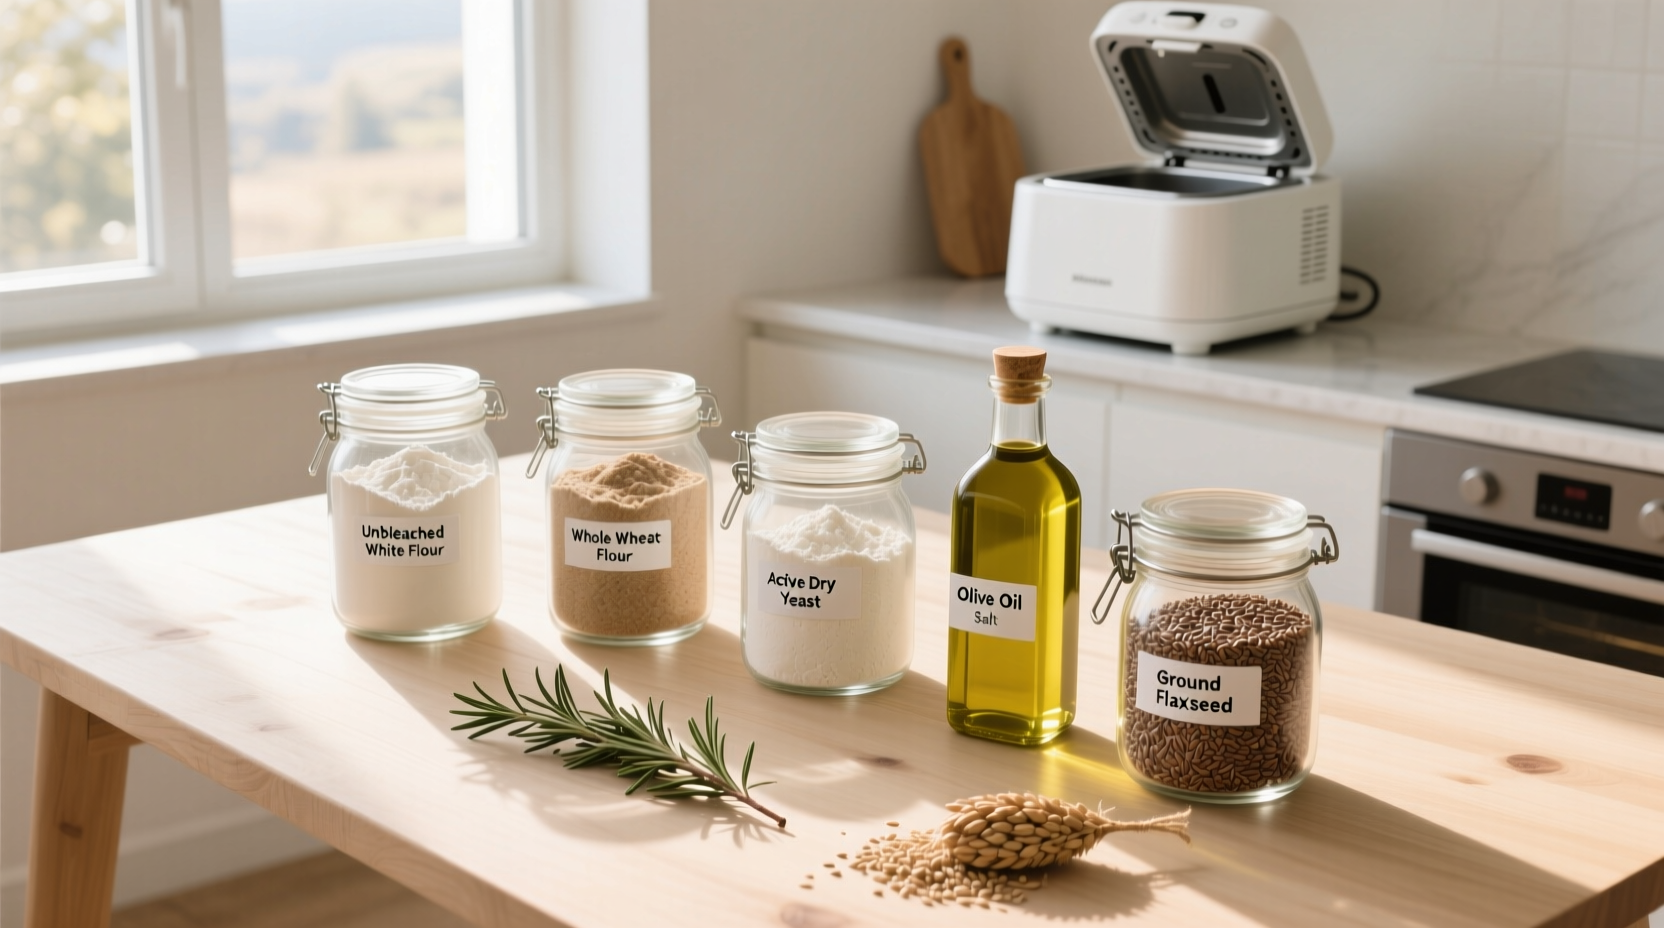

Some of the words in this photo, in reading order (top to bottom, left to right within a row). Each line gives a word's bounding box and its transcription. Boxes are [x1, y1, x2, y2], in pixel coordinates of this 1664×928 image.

[362, 524, 444, 540] Unbleached
[571, 527, 612, 545] Whole
[615, 530, 662, 545] Wheat
[365, 543, 405, 557] White
[408, 544, 445, 557] Flour
[597, 548, 633, 562] Flour
[809, 575, 836, 594] Dry
[780, 591, 821, 609] Yeast
[957, 586, 995, 606] Olive
[999, 593, 1022, 611] Oil
[974, 610, 999, 626] Salt
[1157, 669, 1221, 691] Ground
[1156, 689, 1233, 713] Flaxseed
